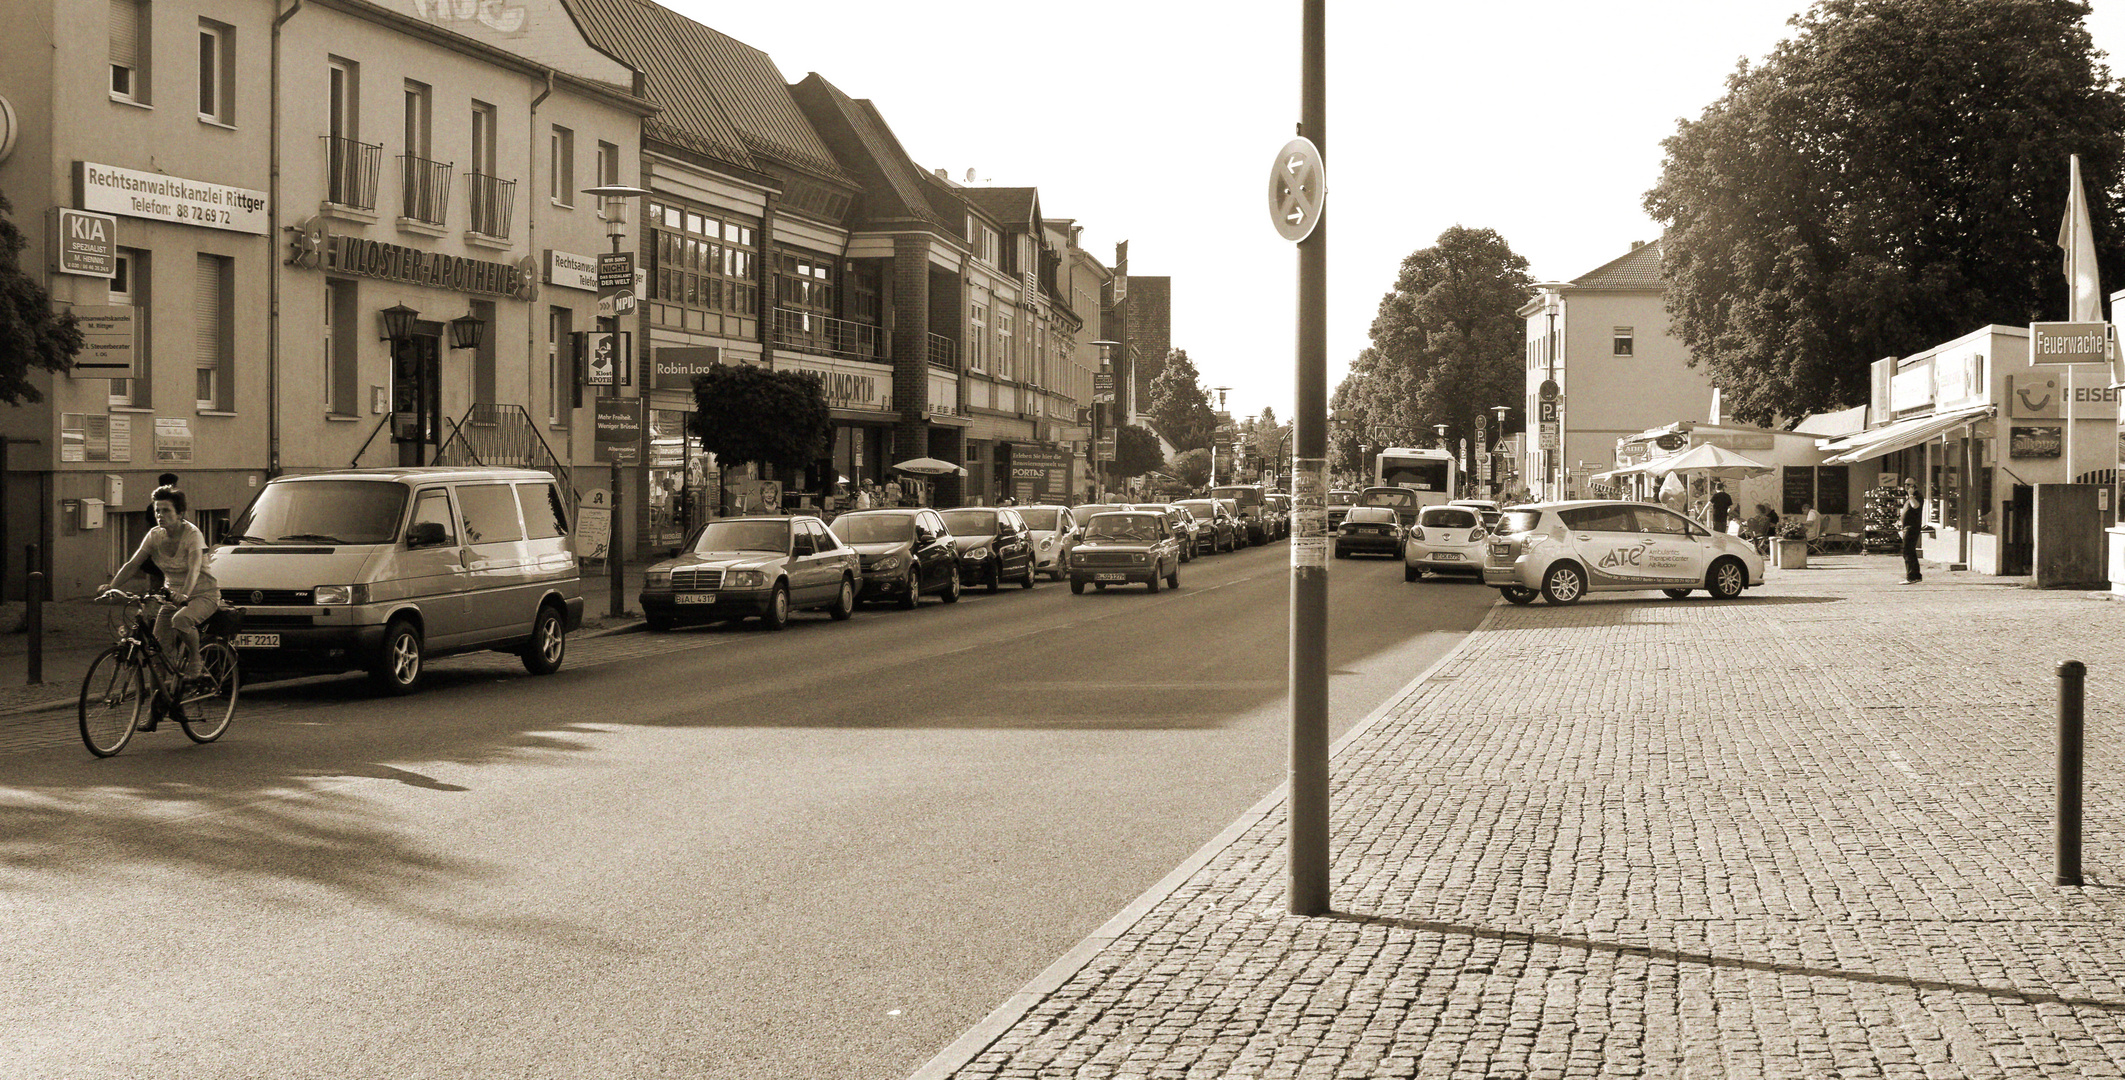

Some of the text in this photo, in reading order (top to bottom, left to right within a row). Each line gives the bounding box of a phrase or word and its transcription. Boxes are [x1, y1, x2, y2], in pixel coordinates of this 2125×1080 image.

[89, 168, 265, 213] Rechtsanwaltskanzlei Rittger
[131, 197, 230, 224] Telefon: 88 72 69 72
[72, 216, 106, 242] KIA
[72, 242, 107, 254] SPEZIALIST
[337, 235, 515, 297] KLOSTER-APOTHEKE
[555, 255, 597, 274] Rechtsanwal
[602, 264, 628, 272] NICHT
[615, 296, 634, 311] NPD
[2037, 331, 2103, 354] Feuerwache
[657, 362, 713, 374] Robin Loo
[1543, 404, 1553, 420] P
[1012, 468, 1045, 477] PORTAS
[697, 595, 715, 603] 4317
[240, 636, 279, 646] HF 2212
